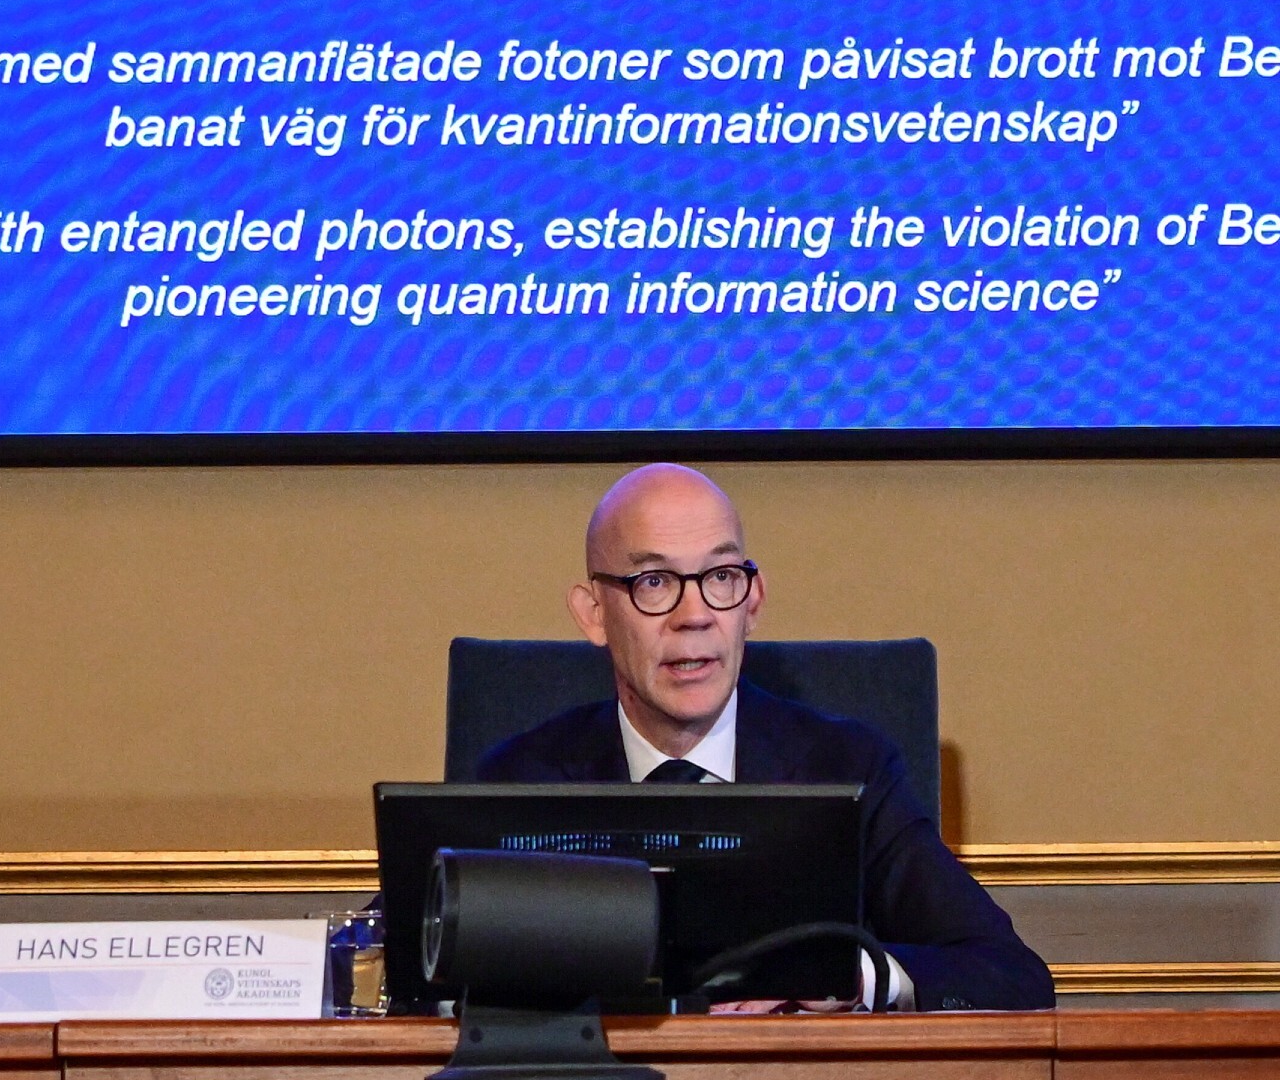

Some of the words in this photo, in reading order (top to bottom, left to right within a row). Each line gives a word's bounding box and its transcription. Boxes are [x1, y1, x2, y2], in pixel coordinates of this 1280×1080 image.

[108, 39, 482, 83] sammanflätade
[497, 39, 673, 82] fotoner
[683, 48, 784, 80] som
[798, 36, 977, 90] påvisat
[988, 37, 1100, 79] brott
[1112, 37, 1206, 78] mot
[105, 105, 246, 147] banat
[260, 107, 347, 157] väg
[362, 104, 431, 146] för
[440, 100, 1140, 153] kvantinformationsvetenskap”
[60, 209, 306, 262] entangled
[315, 208, 524, 262] photons,
[544, 206, 835, 259] establishing
[850, 205, 925, 248] the
[942, 204, 1140, 247] violation
[1156, 203, 1209, 246] of
[120, 273, 382, 328] pioneering
[397, 272, 609, 326] quantum
[625, 270, 897, 314] information
[914, 268, 1122, 312] science”
[17, 938, 97, 960] HANS
[109, 935, 264, 958] ELLEGREN
